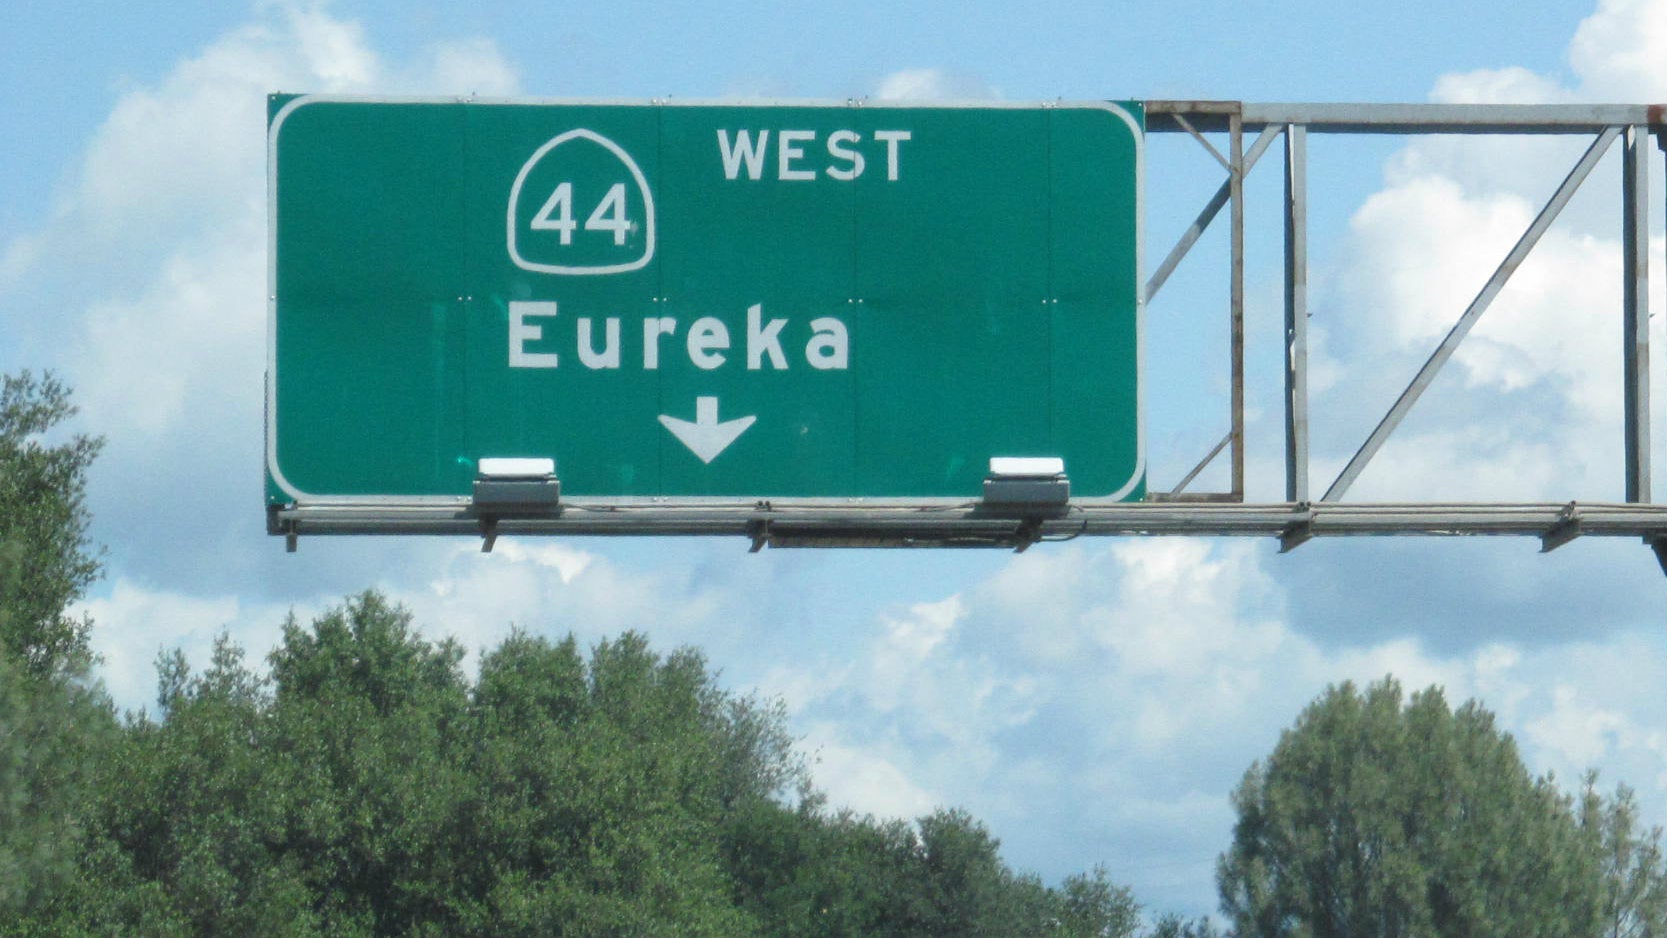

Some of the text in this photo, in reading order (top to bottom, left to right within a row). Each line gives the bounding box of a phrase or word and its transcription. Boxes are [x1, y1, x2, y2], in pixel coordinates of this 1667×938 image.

[716, 129, 913, 181] WEST
[530, 182, 632, 246] 44
[507, 301, 849, 370] Eureka
